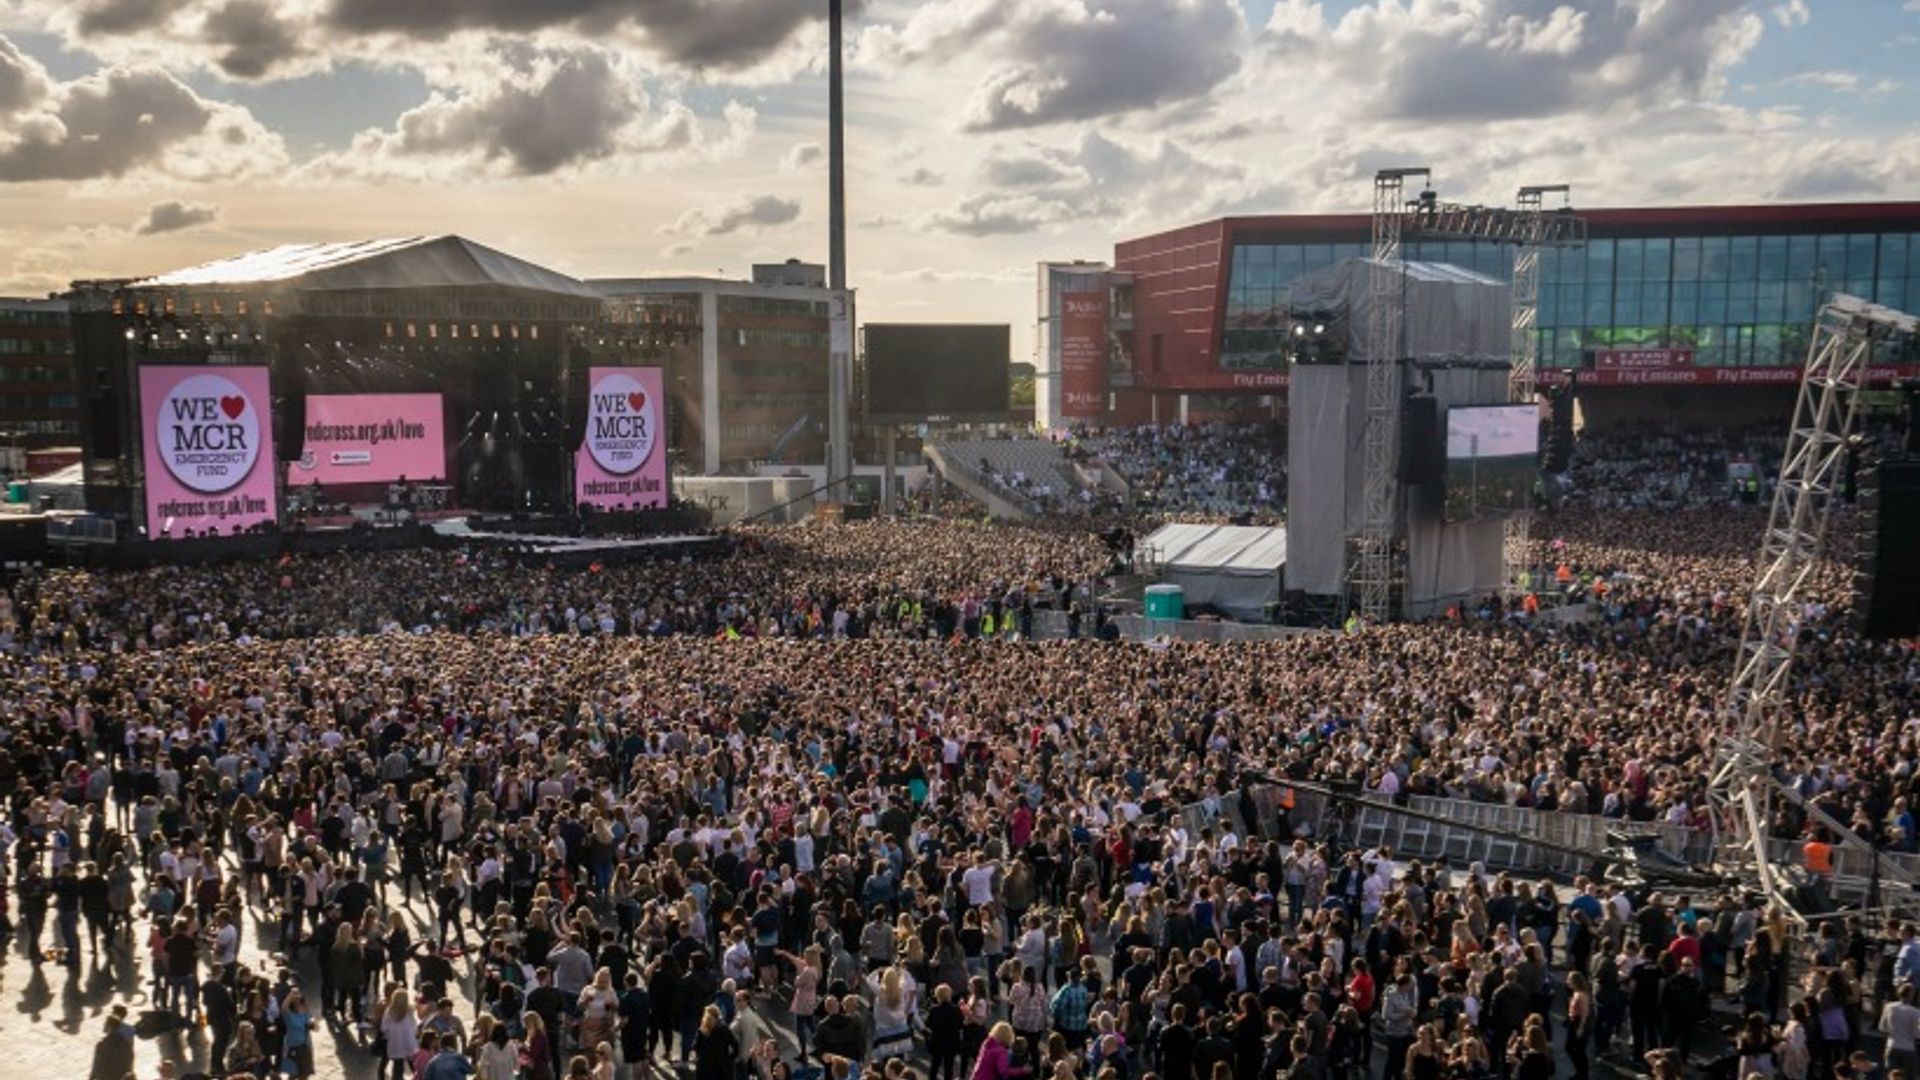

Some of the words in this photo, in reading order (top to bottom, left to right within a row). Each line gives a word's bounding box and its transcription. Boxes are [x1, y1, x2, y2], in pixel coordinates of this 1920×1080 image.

[1233, 373, 1254, 387] Fly
[1641, 369, 1697, 382] Emirates
[1716, 369, 1738, 383] Fly
[1740, 369, 1797, 381] Emirates
[172, 397, 218, 421] WE
[594, 393, 627, 413] WE
[172, 424, 247, 451] MCR
[305, 418, 425, 445] edcross.org.uk/love
[594, 416, 647, 439] MCR
[174, 452, 247, 464] EMERGENCY
[197, 465, 228, 477] FUND
[157, 495, 266, 519] redcross.org.uk/love
